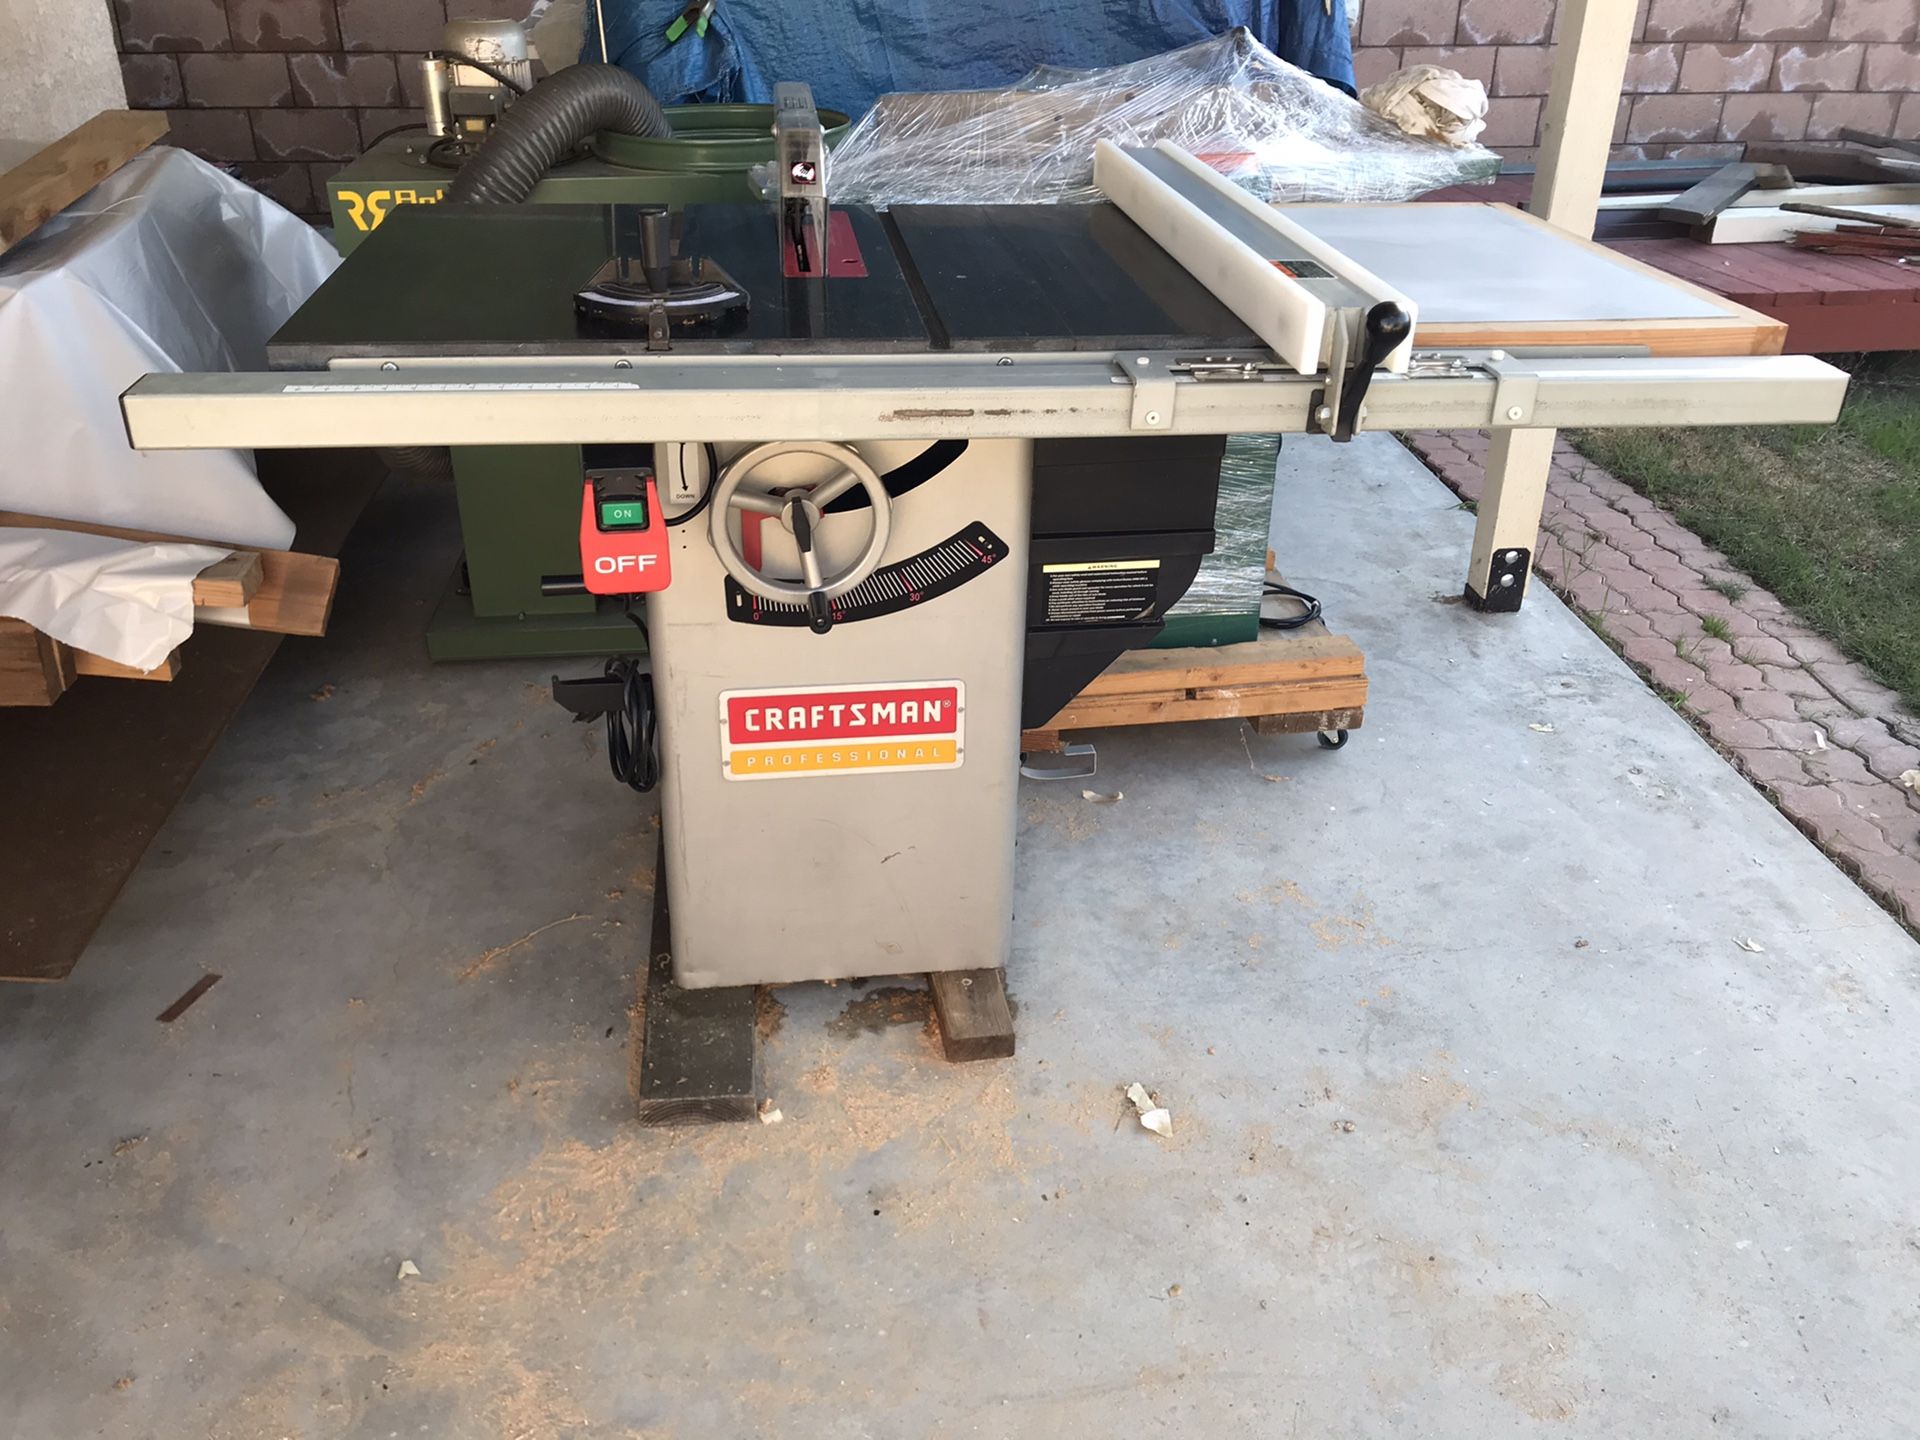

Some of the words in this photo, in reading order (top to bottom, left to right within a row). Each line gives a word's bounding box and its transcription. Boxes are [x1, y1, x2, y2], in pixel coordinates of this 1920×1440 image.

[613, 509, 632, 519] ON
[594, 554, 658, 574] OFF
[747, 748, 941, 767] PROFESSIONAL
